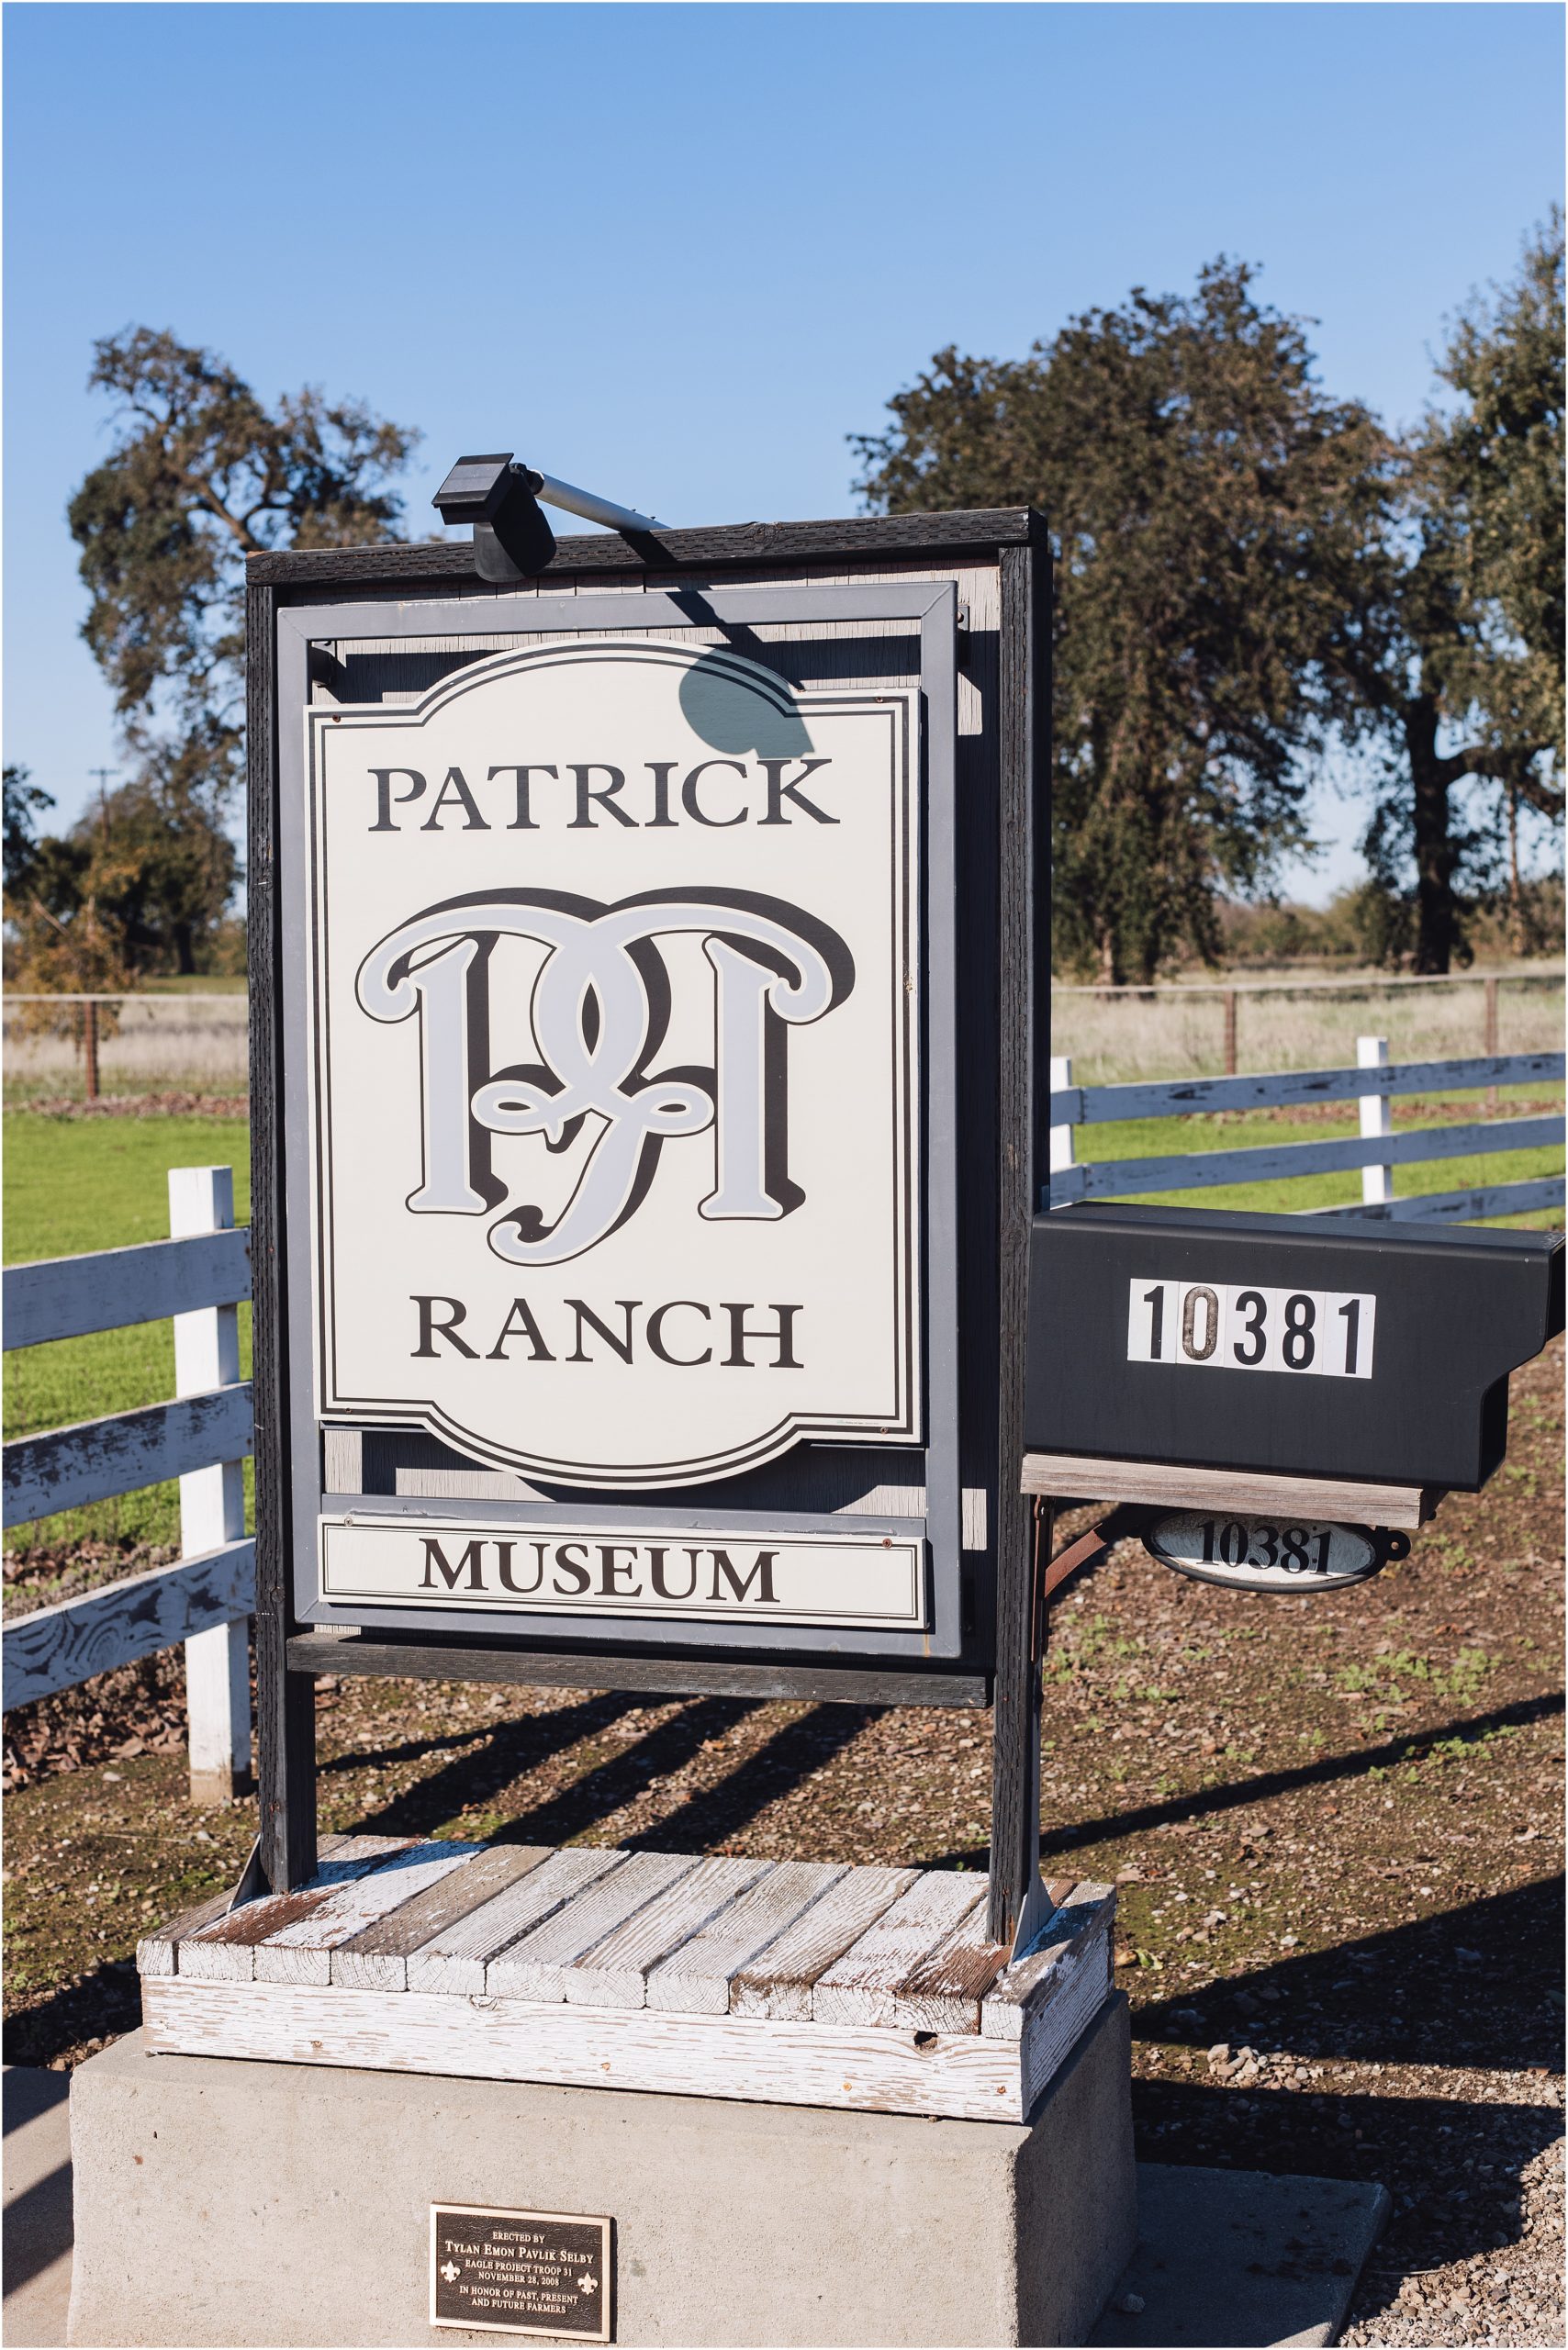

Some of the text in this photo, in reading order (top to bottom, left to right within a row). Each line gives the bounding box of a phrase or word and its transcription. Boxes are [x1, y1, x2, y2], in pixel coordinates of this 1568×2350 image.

[367, 758, 841, 832] PATRICK
[409, 1295, 804, 1369] RANCH
[1143, 1285, 1361, 1375] 10381
[1196, 1521, 1332, 1577] 10381
[418, 1538, 780, 1603] MUSEUM
[492, 2232, 545, 2244] ERECTED BY
[465, 2259, 573, 2277] EAGLE PROJECT TROOP 31
[478, 2271, 560, 2287] NOVEMBER 28, 2008
[459, 2285, 579, 2304] IN HONOR OF PAST, PRESENT
[471, 2298, 566, 2314] AND FUTURE FARMERS
